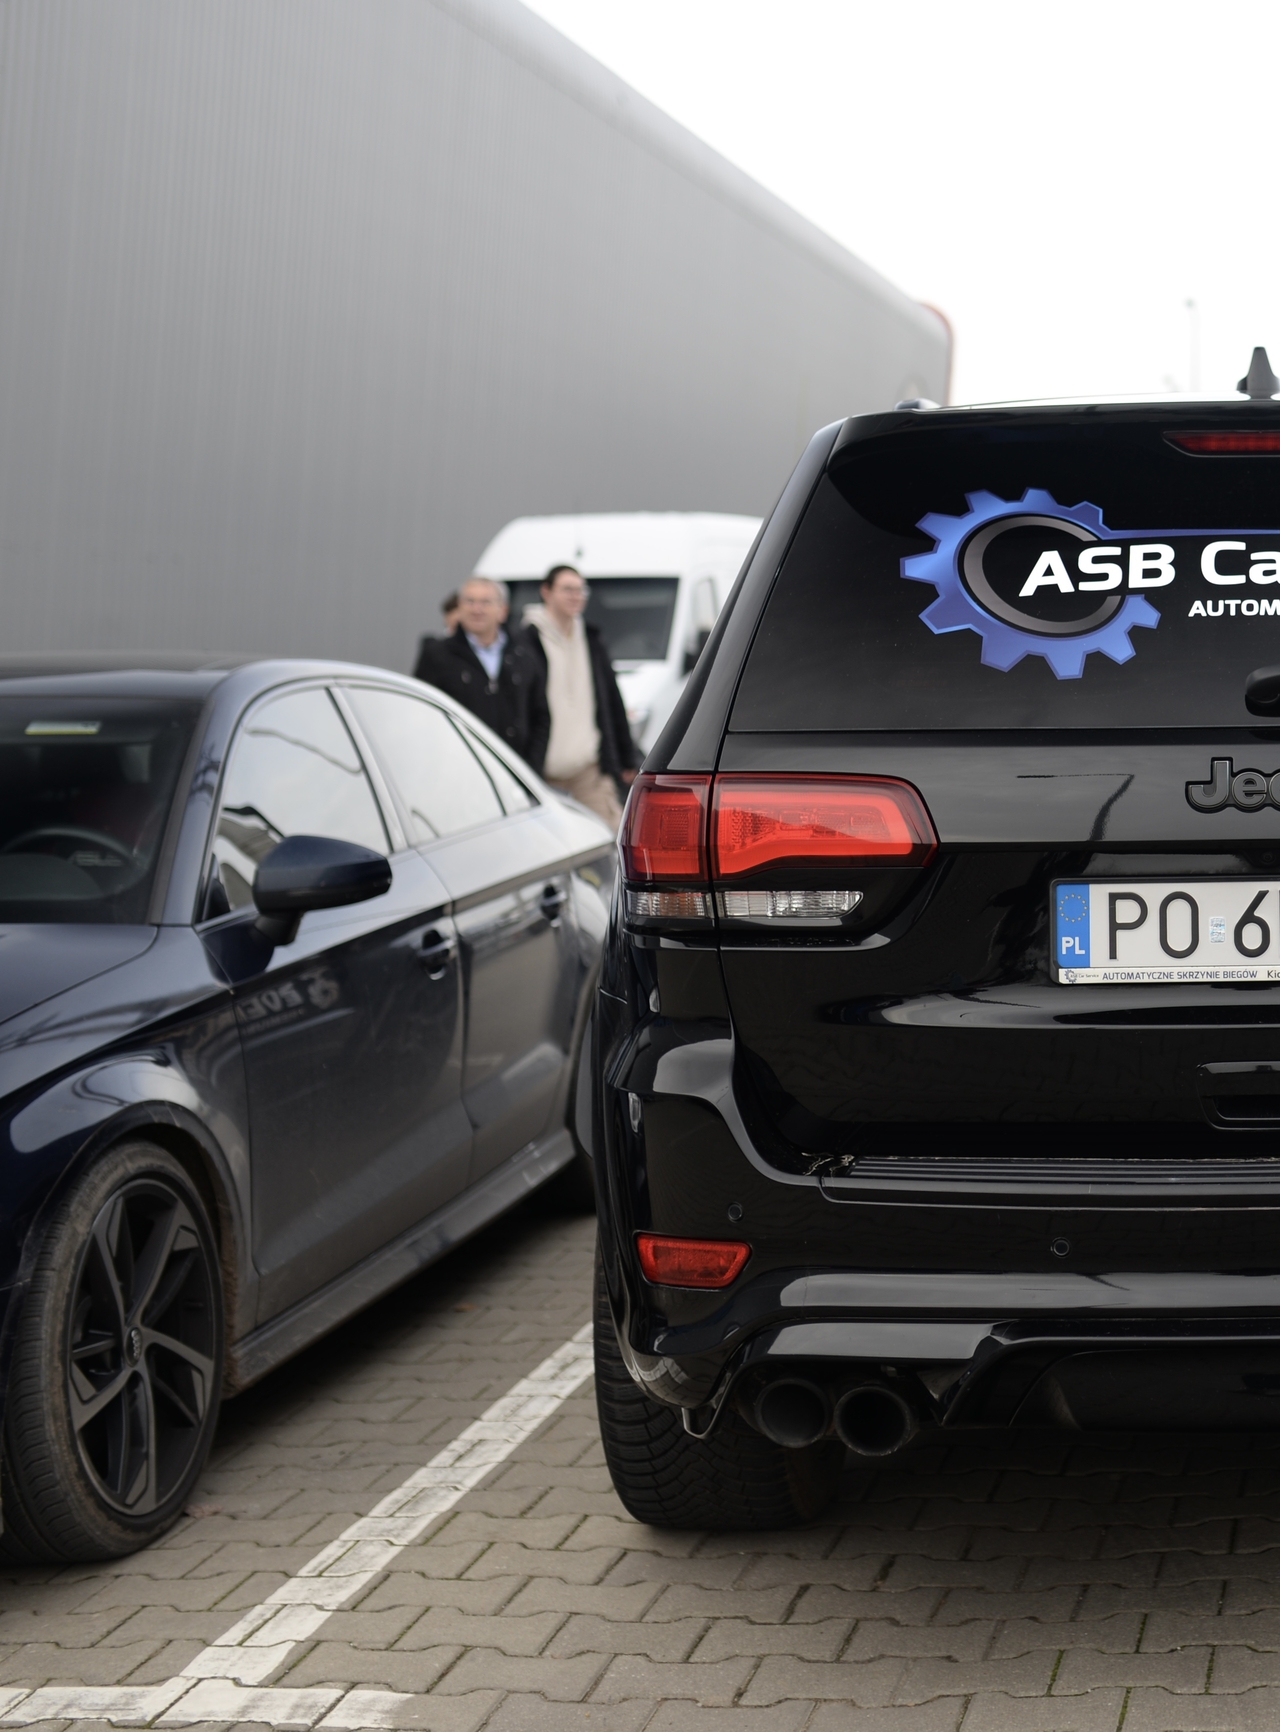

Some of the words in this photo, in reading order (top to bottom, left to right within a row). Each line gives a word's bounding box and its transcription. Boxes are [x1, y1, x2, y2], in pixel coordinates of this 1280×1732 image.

[1018, 543, 1176, 598] ASB
[1061, 936, 1086, 955] PL
[1102, 971, 1174, 980] AUTOMATYCZNE
[1177, 970, 1220, 979] SKRZYNIE
[1223, 968, 1258, 979] BIEGÓW
